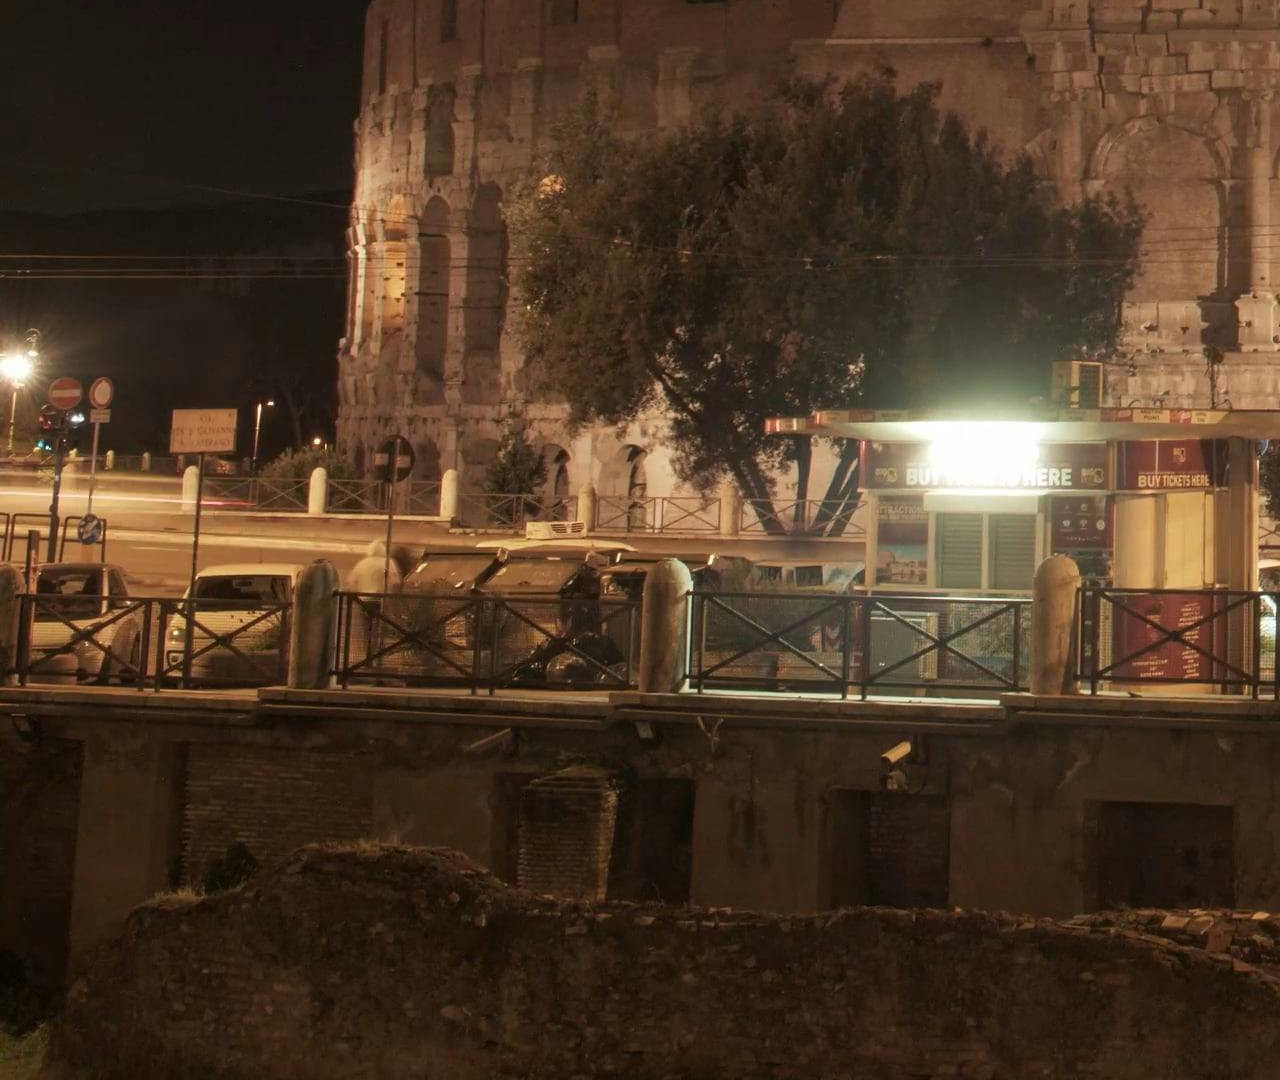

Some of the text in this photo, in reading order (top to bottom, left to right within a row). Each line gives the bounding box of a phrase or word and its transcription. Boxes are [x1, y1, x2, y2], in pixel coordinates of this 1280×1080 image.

[906, 468, 940, 486] BUY
[1023, 468, 1073, 487] HERE
[1138, 475, 1210, 487] BUY TICKETS HERE
